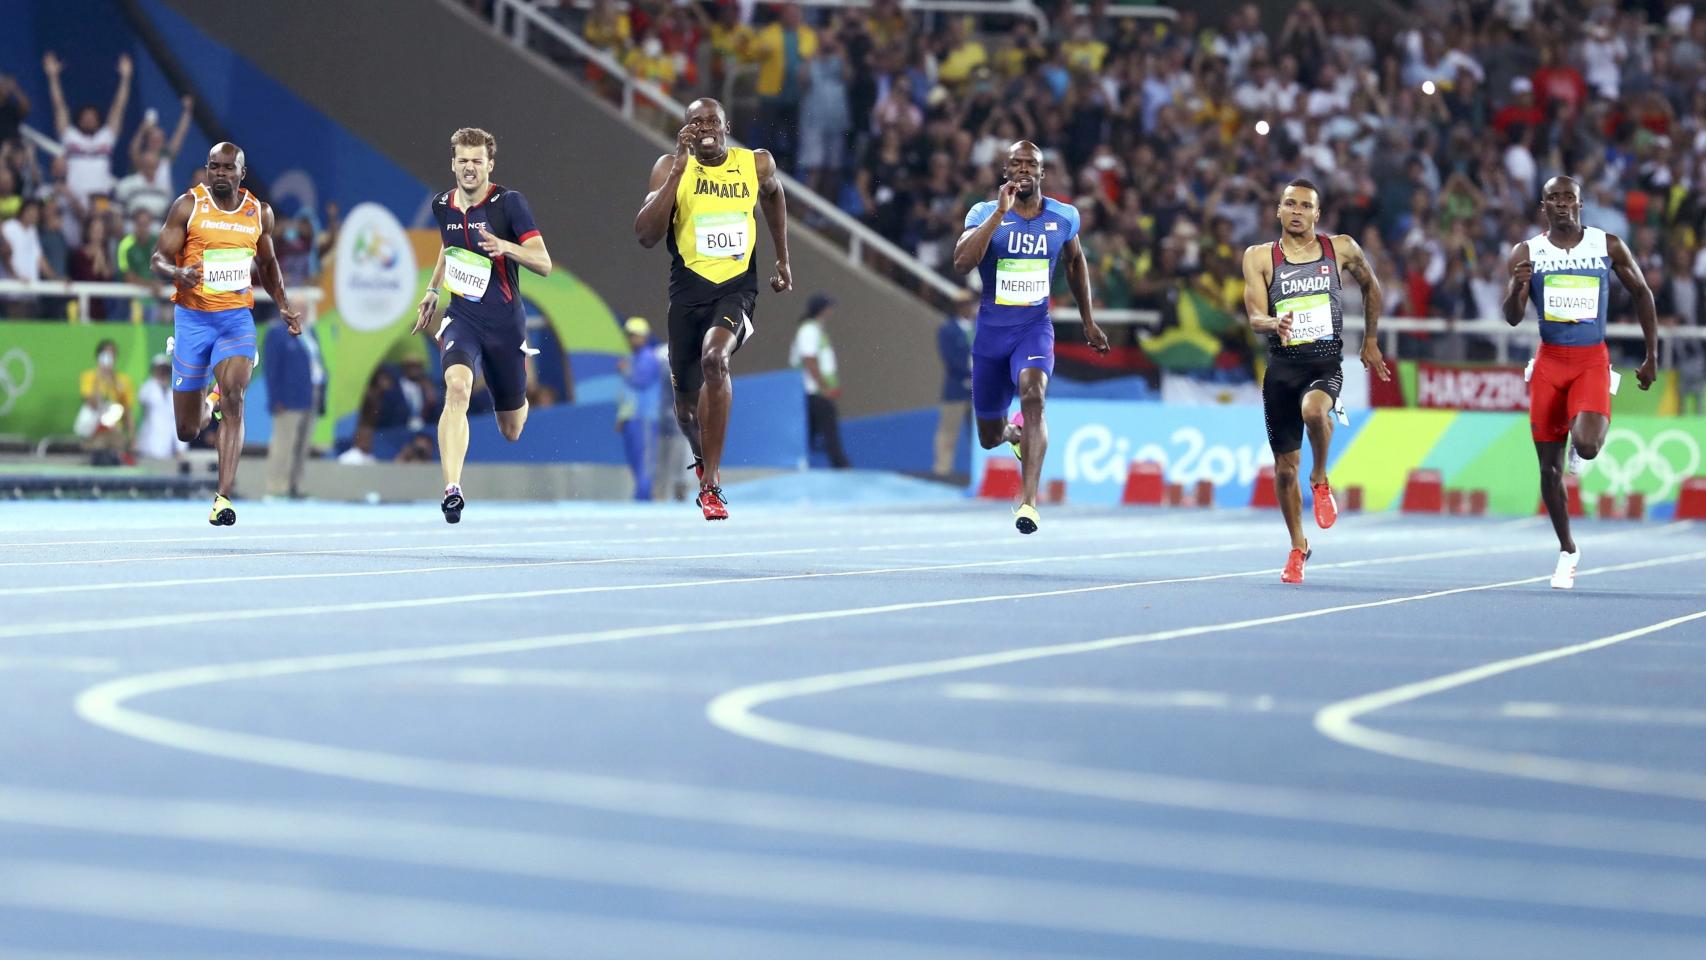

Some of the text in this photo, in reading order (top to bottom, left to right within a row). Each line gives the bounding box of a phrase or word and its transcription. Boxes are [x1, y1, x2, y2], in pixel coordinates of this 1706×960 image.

[693, 177, 750, 199] JAMAICA
[446, 222, 487, 231] FRANCE
[707, 231, 744, 249] BOLT
[1007, 231, 1048, 256] USA
[1533, 256, 1608, 274] PANAMA
[448, 264, 487, 290] LEMAITRE
[1001, 279, 1047, 292] MERRITT
[1281, 276, 1331, 295] CANADA
[1549, 296, 1595, 310] EDWARD
[1299, 312, 1313, 324] DE
